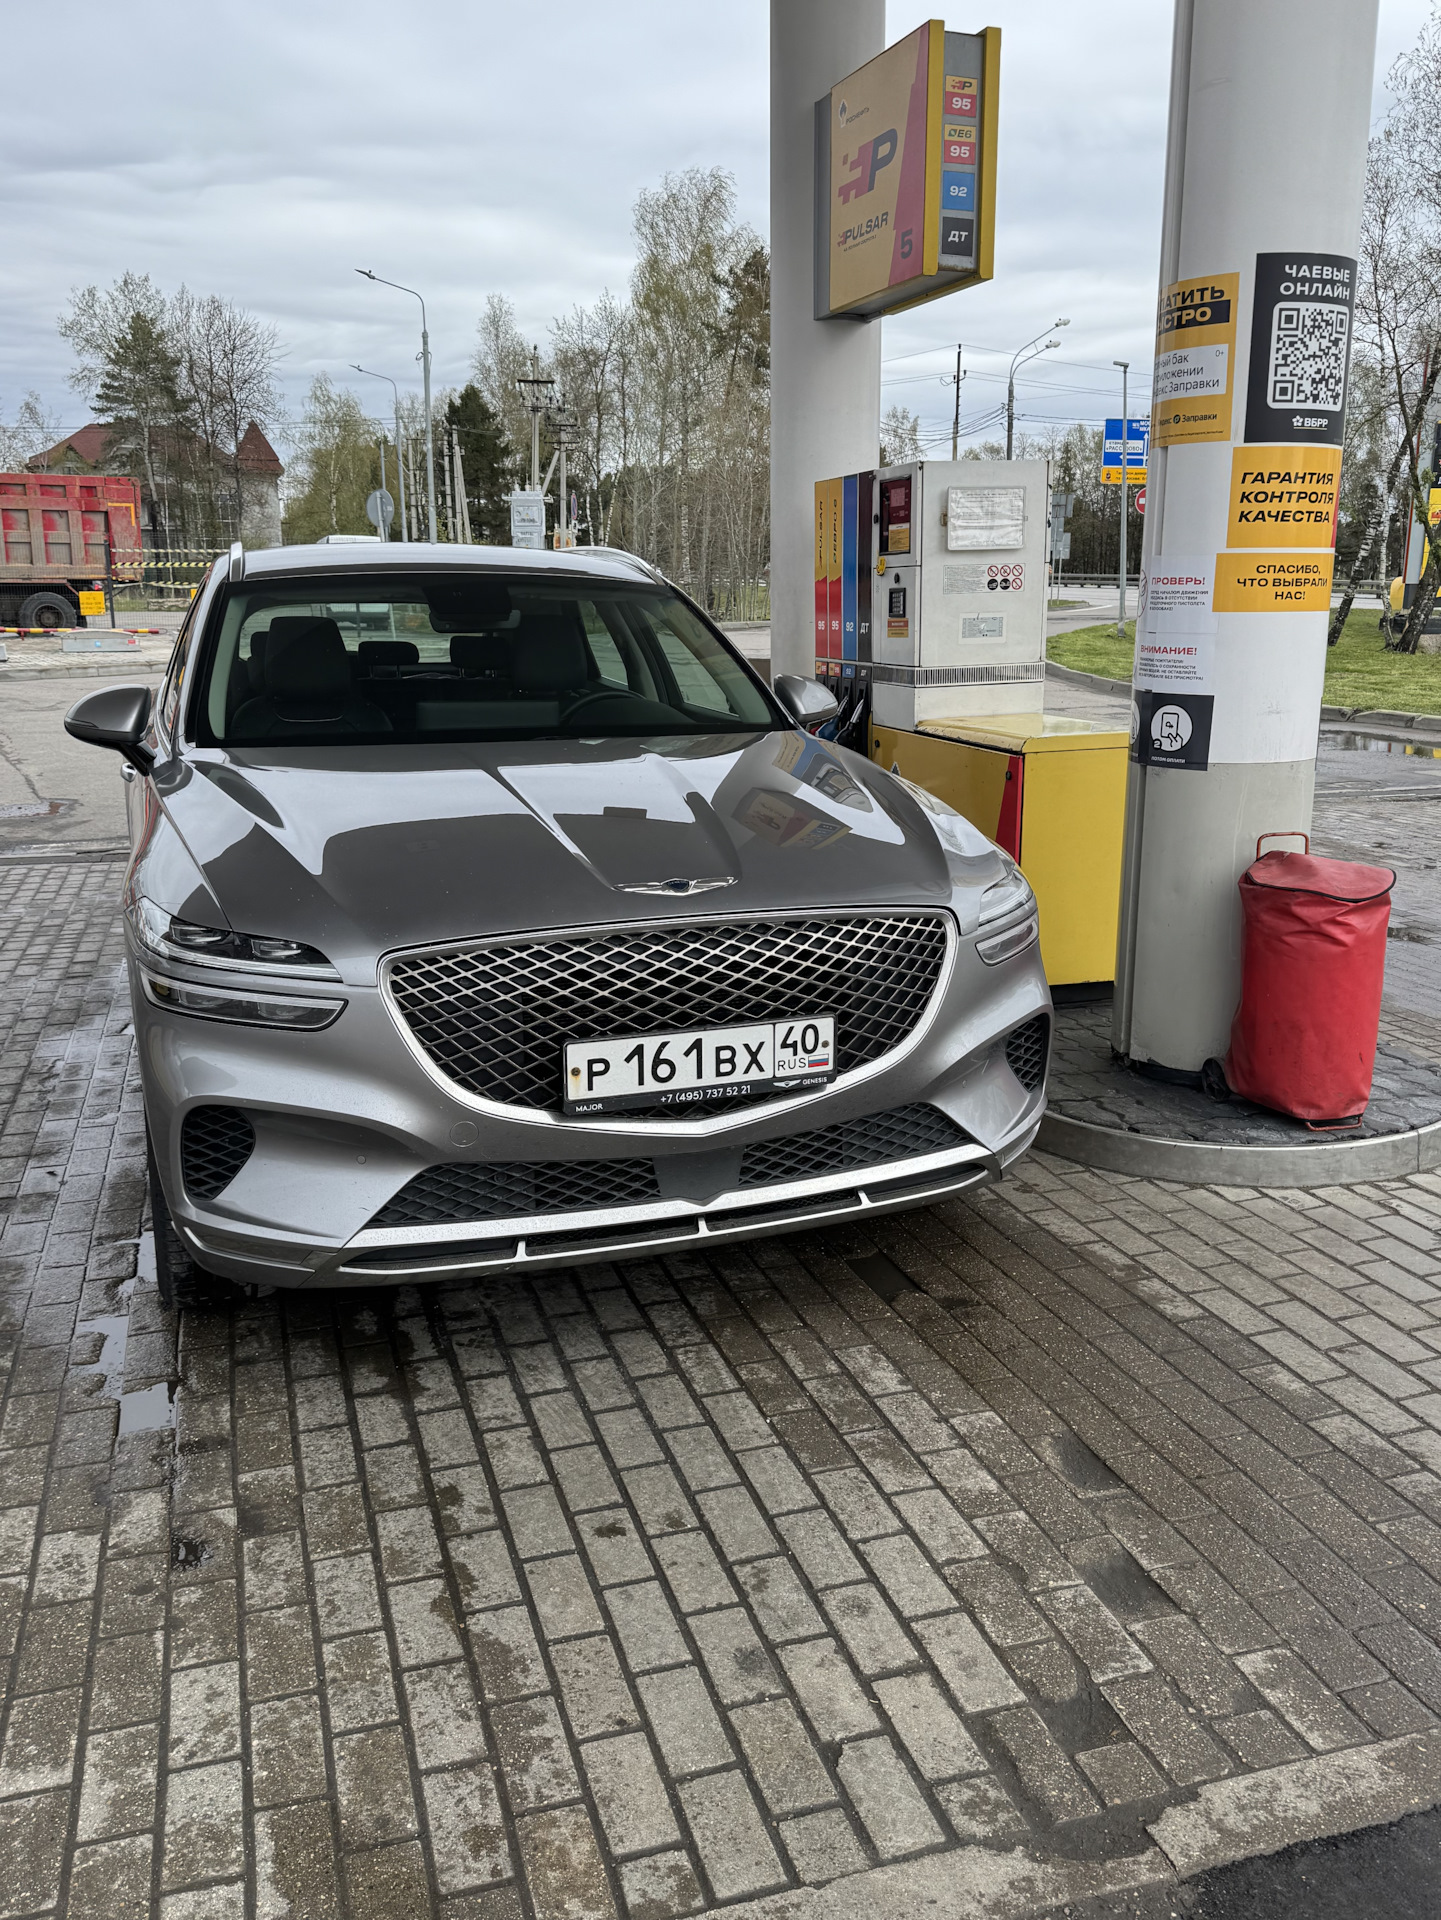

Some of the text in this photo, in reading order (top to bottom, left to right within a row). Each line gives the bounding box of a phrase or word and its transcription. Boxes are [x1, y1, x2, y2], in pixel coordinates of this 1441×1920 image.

[952, 97, 971, 110] 95
[950, 146, 970, 158] 95
[950, 186, 968, 197] 92
[844, 211, 889, 244] PULSAR
[948, 231, 968, 242] ДТ
[900, 228, 912, 260] 5
[1284, 264, 1350, 282] ЧАЕВЫЕ
[1280, 282, 1350, 300] ОНЛАЙН
[1158, 307, 1212, 331] ЫСТРО
[1172, 353, 1189, 365] бак
[1168, 378, 1219, 392] Заправки
[1182, 414, 1217, 423] Заправки
[1304, 418, 1328, 427] ВБРР
[1241, 472, 1333, 485] ГАРАНТИЯ
[1240, 491, 1334, 504] КОНТРОЛЯ
[1238, 510, 1330, 523] КАЧЕСТВА
[1256, 564, 1320, 575] СПАСИБО,
[1152, 577, 1205, 585] ПРОВЕРЬ!
[1237, 578, 1327, 587] ЧТО ВЫБРАЛИ
[1274, 591, 1306, 600] НАС!
[818, 621, 825, 630] 95
[832, 621, 839, 630] 95
[846, 622, 854, 631] 92
[860, 622, 869, 634] ДТ
[1140, 645, 1197, 655] ВНИМАНИЕ!
[780, 1024, 820, 1056] 40
[777, 1057, 806, 1072] RUS
[802, 1077, 828, 1086] GENESIS
[660, 1085, 751, 1104] +7 (495) 737 52 21
[575, 1103, 604, 1113] MAJOR
